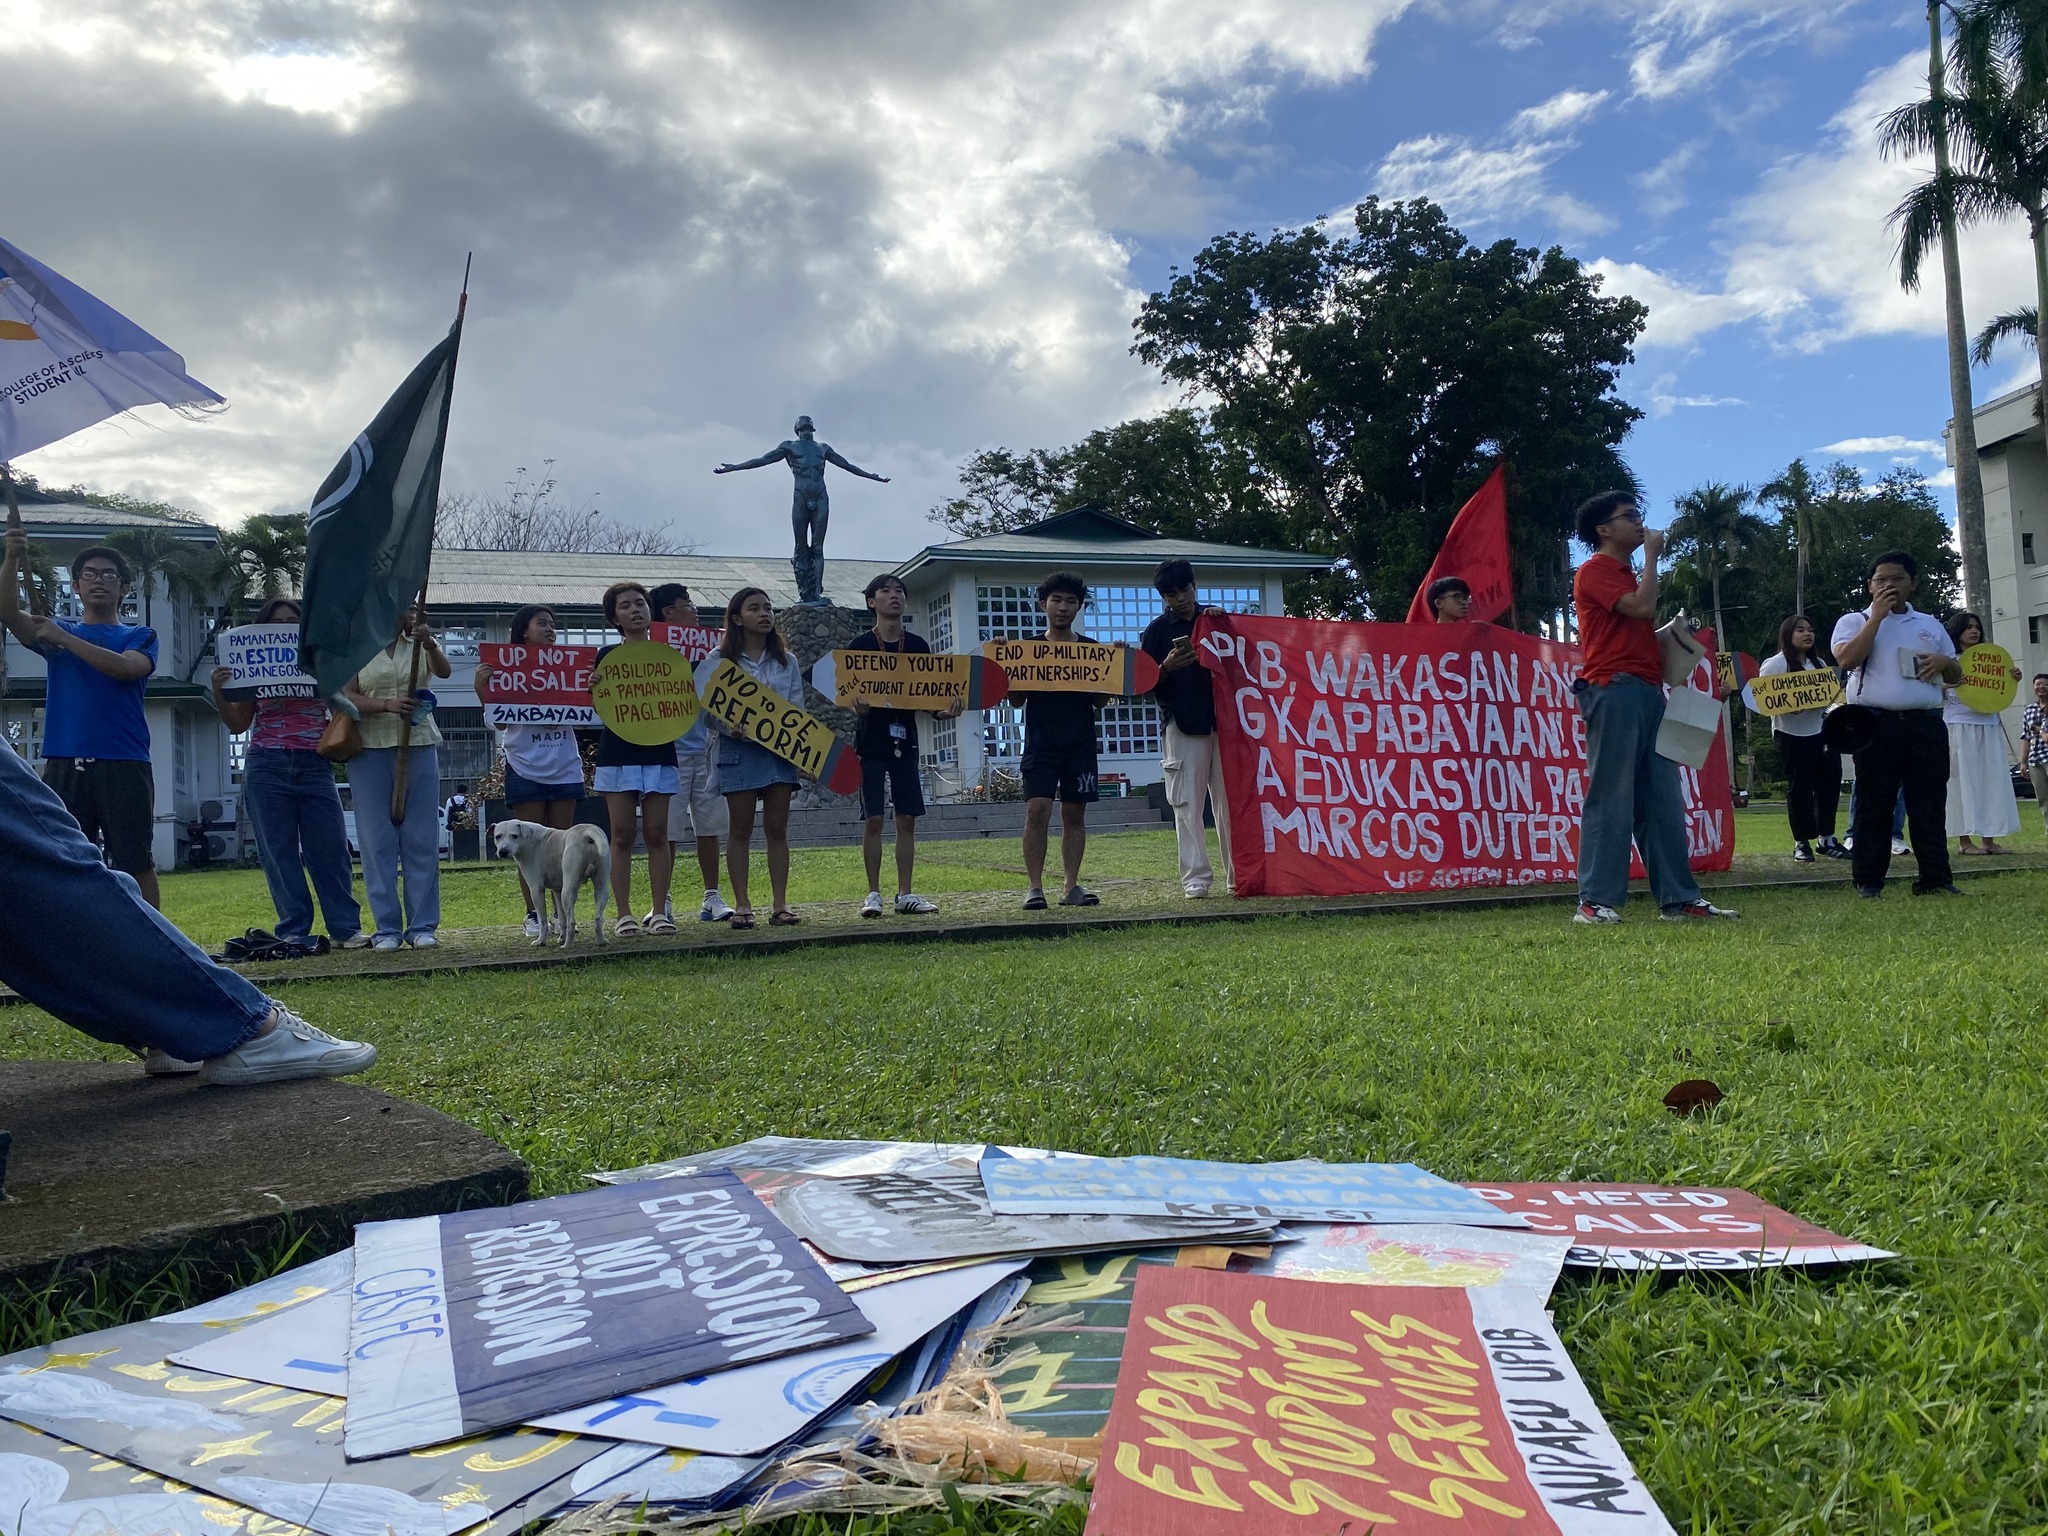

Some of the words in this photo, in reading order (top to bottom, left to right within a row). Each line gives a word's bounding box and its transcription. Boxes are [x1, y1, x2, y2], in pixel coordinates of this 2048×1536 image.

[41, 364, 56, 376] OF
[14, 370, 72, 404] STUDENT
[668, 626, 722, 649] EXPAN
[229, 653, 243, 664] SA
[245, 647, 299, 665] ESTUD
[499, 648, 527, 667] UP
[539, 648, 579, 666] NOT
[845, 655, 897, 671] DEFEND
[907, 656, 953, 673] YOUTH
[995, 645, 1023, 661] END
[1033, 645, 1116, 662] UP-MILITARY
[1972, 652, 2001, 664] EXPAND
[248, 666, 260, 678] SA
[489, 671, 528, 694] FOR
[531, 669, 589, 692] SALE
[603, 662, 672, 681] PASILIDAD
[1305, 650, 1521, 702] WAKASAN
[1971, 664, 2006, 677] STUDENT
[256, 685, 314, 699] SAKBAYAN
[615, 680, 695, 699] PAMANTASAN
[838, 673, 860, 697] and
[859, 680, 905, 696] STUDENT
[908, 680, 967, 697] LEADERS!
[1964, 675, 2006, 695] SERVICES!
[720, 665, 758, 697] NO
[760, 695, 775, 713] TO
[780, 709, 819, 742] GE
[1765, 692, 1792, 710] OUR
[1793, 684, 1833, 708] SPACES!
[492, 705, 594, 723] SAKBAYAN
[614, 700, 693, 723] IPAGLABAN!
[531, 730, 567, 743] MADE
[708, 686, 822, 772] REFORM!
[1260, 801, 1444, 863] MARCOS
[1383, 869, 1425, 889] UP
[1428, 866, 1503, 888] ACTION
[1506, 867, 1547, 886] LOS
[1551, 1190, 1729, 1208] HEED
[1510, 1211, 1764, 1234] CALLS
[577, 1235, 685, 1298] NOT
[1480, 1327, 1567, 1383] UPLB
[1113, 1303, 1260, 1513] EXPAND
[1248, 1299, 1397, 1525] STUDENT
[1350, 1308, 1527, 1519] SERVICES
